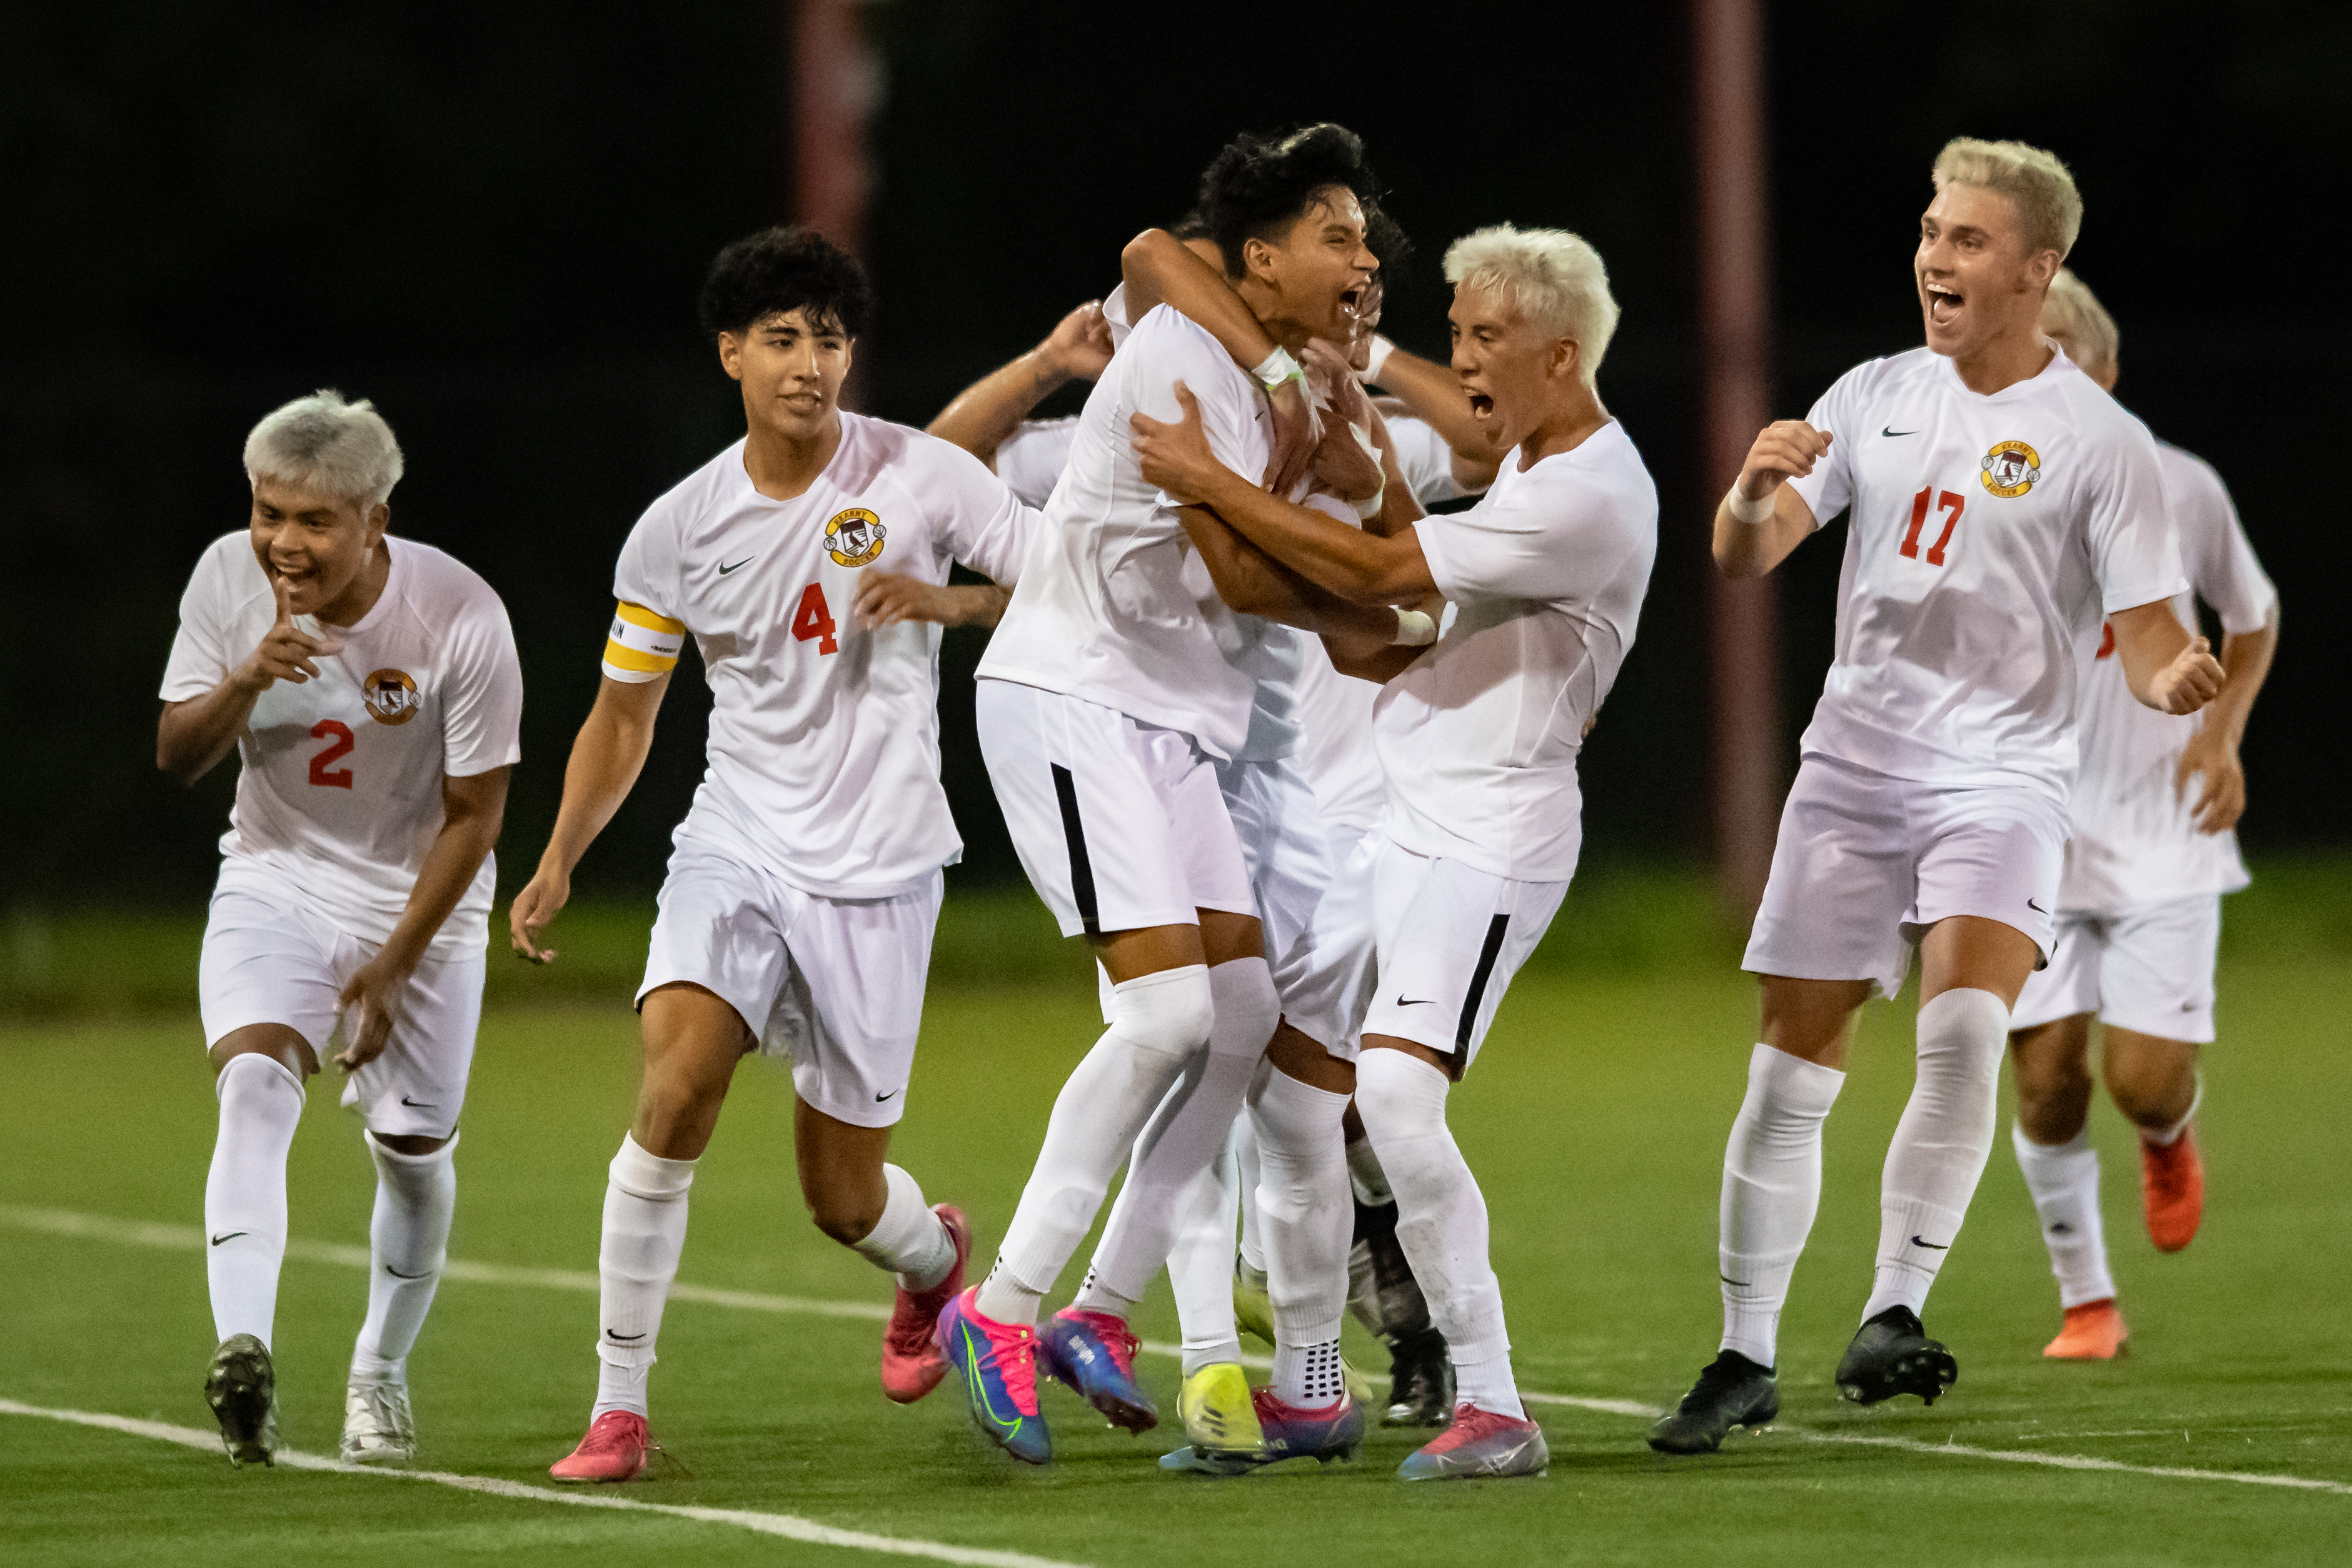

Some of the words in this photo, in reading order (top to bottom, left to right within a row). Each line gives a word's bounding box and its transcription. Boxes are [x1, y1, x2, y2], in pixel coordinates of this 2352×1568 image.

[1899, 485, 1964, 566] 17
[792, 581, 838, 656] 4
[309, 718, 354, 790] 2
